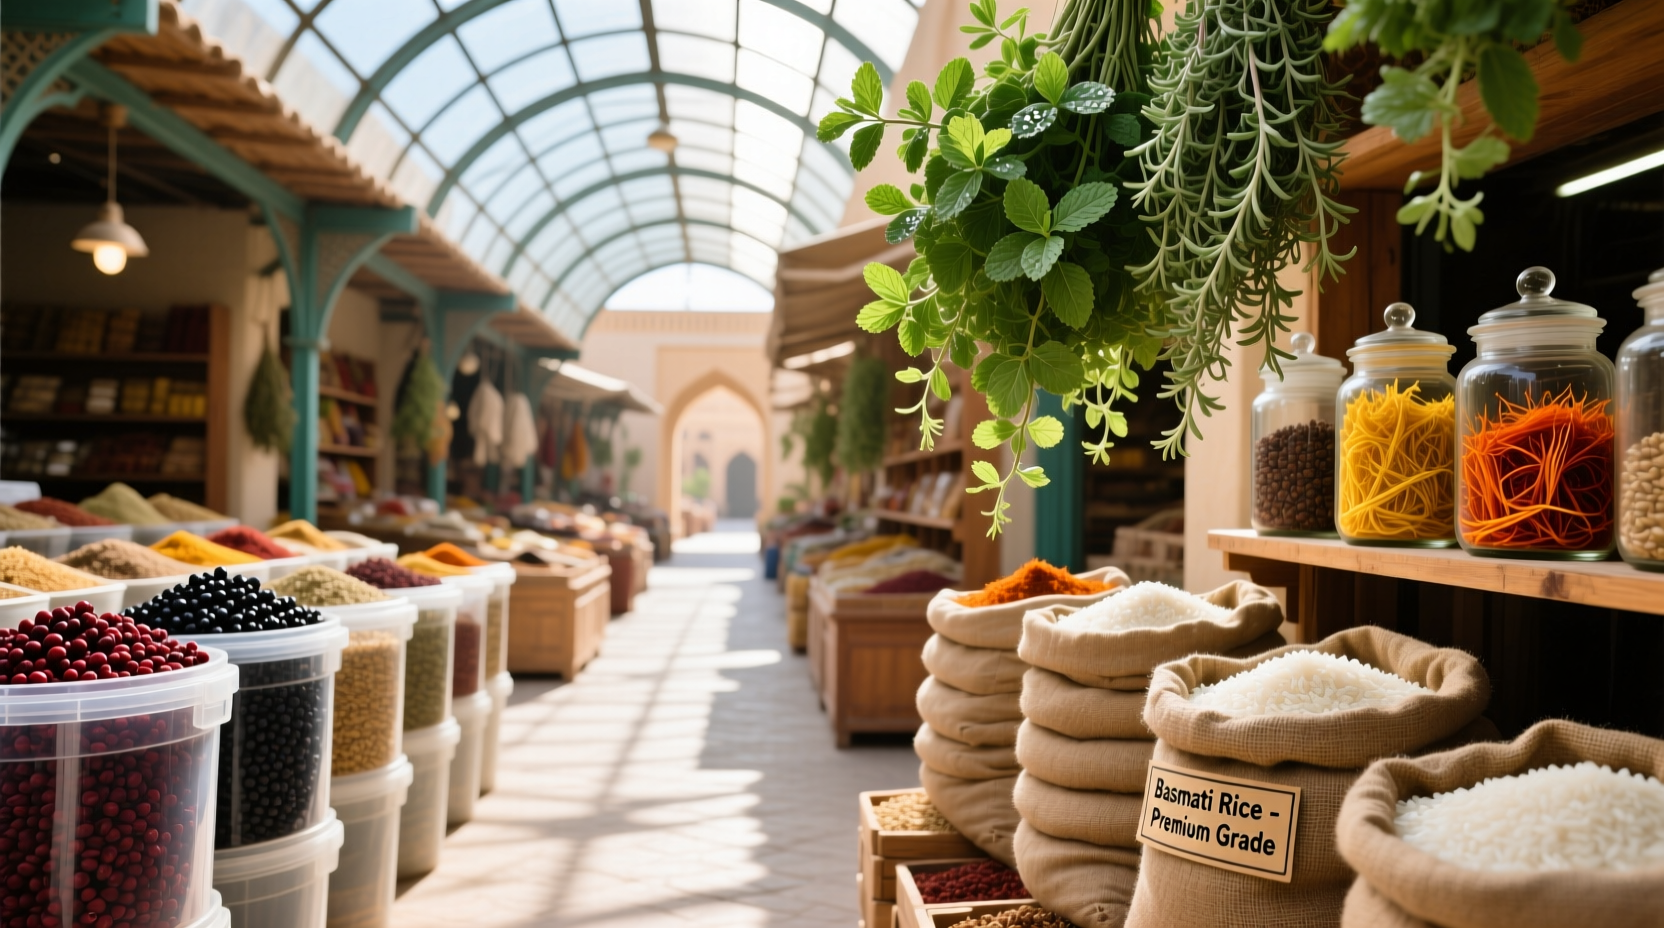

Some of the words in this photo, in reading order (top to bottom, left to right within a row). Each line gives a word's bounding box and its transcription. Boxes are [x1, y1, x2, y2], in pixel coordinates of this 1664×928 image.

[1154, 777, 1214, 812] Basmati
[1218, 792, 1263, 820] Rice
[1150, 807, 1211, 843] Premium
[1216, 823, 1276, 856] Grade
